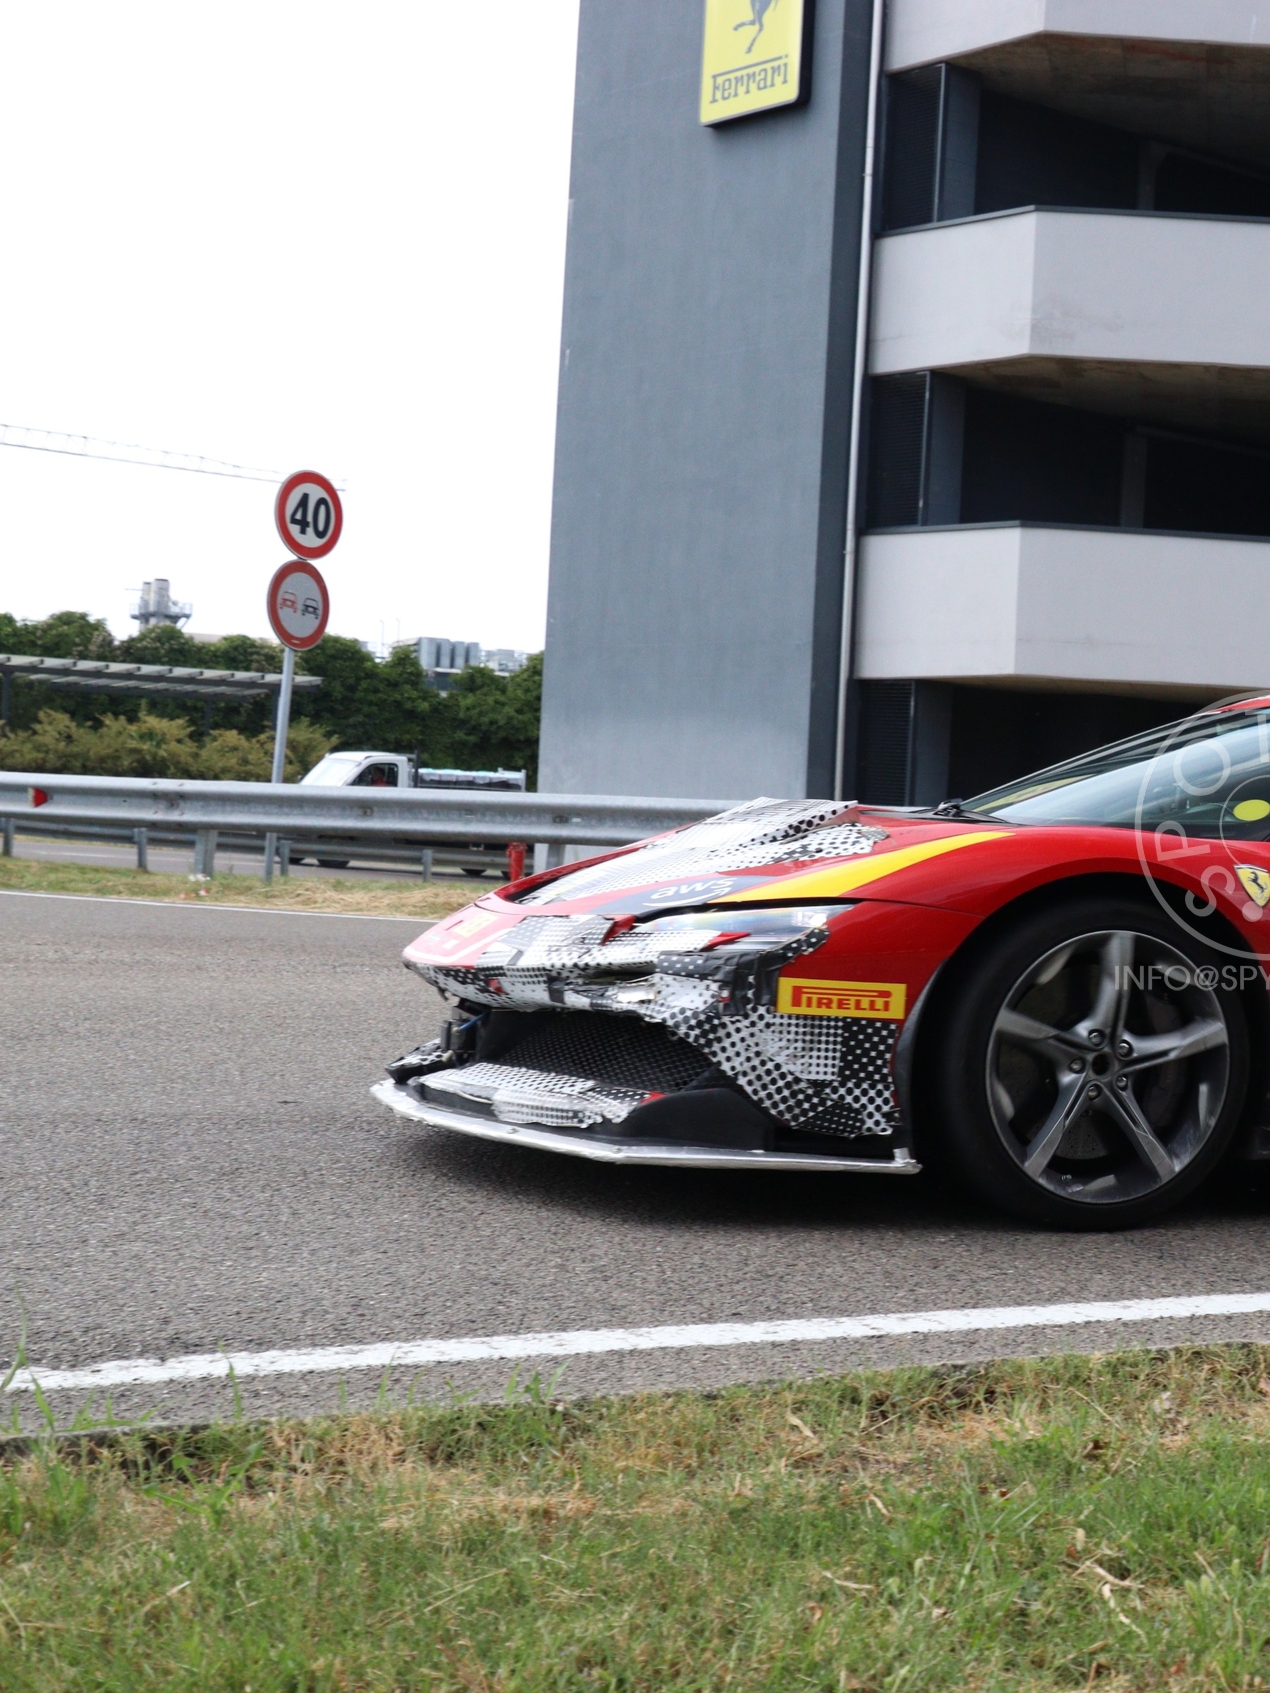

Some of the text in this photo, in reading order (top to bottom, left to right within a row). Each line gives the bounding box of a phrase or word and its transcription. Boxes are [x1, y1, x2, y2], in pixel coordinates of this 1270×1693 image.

[709, 54, 789, 104] Ferrari
[290, 493, 331, 539] 40
[650, 877, 738, 899] aws
[791, 985, 893, 1012] PIRELLI
